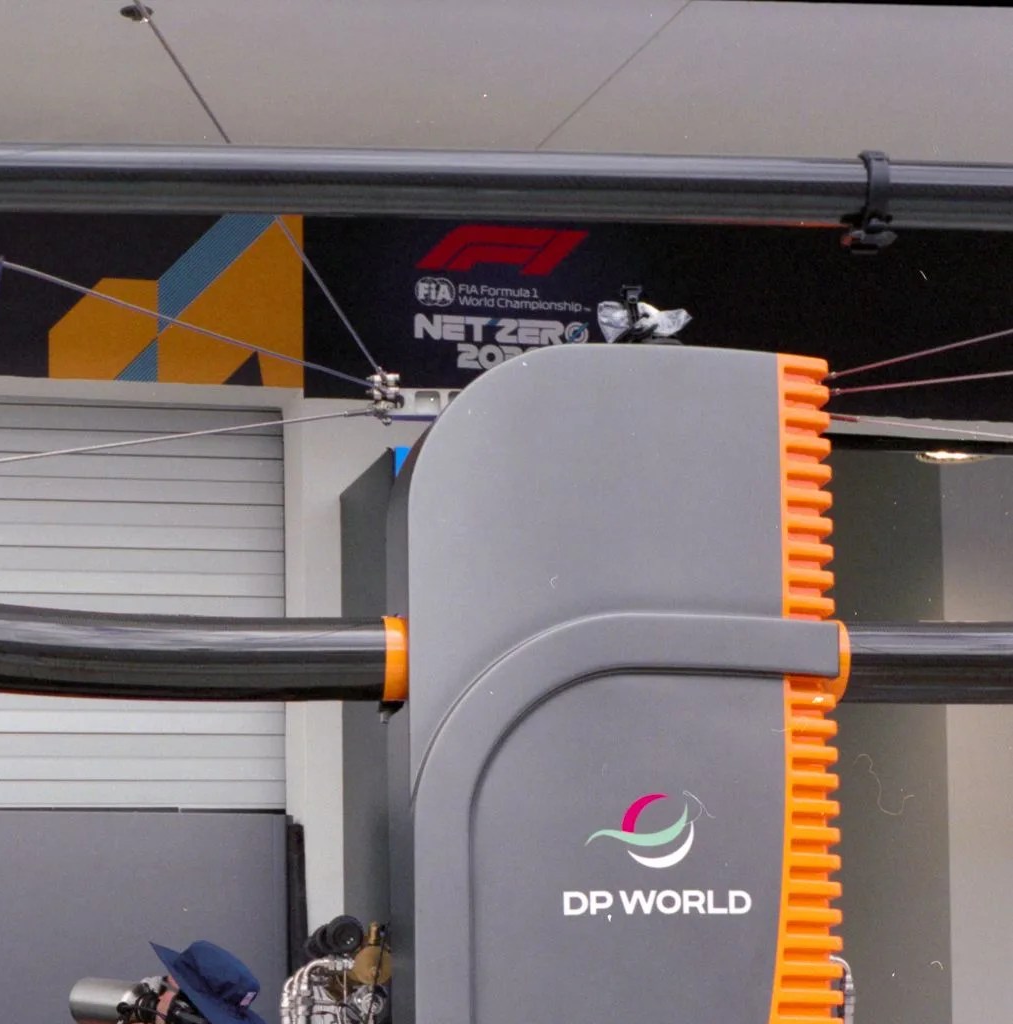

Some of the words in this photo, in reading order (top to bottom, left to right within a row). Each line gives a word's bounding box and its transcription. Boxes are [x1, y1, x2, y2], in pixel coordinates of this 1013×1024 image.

[416, 225, 589, 276] F1
[458, 283, 479, 296] FIA
[480, 285, 531, 298] Formula
[531, 287, 539, 299] 1
[458, 295, 496, 308] World
[496, 298, 582, 313] Championship
[414, 313, 491, 342] NET
[491, 318, 590, 345] ZERO
[563, 891, 614, 916] DP
[619, 890, 752, 915] WORLD
